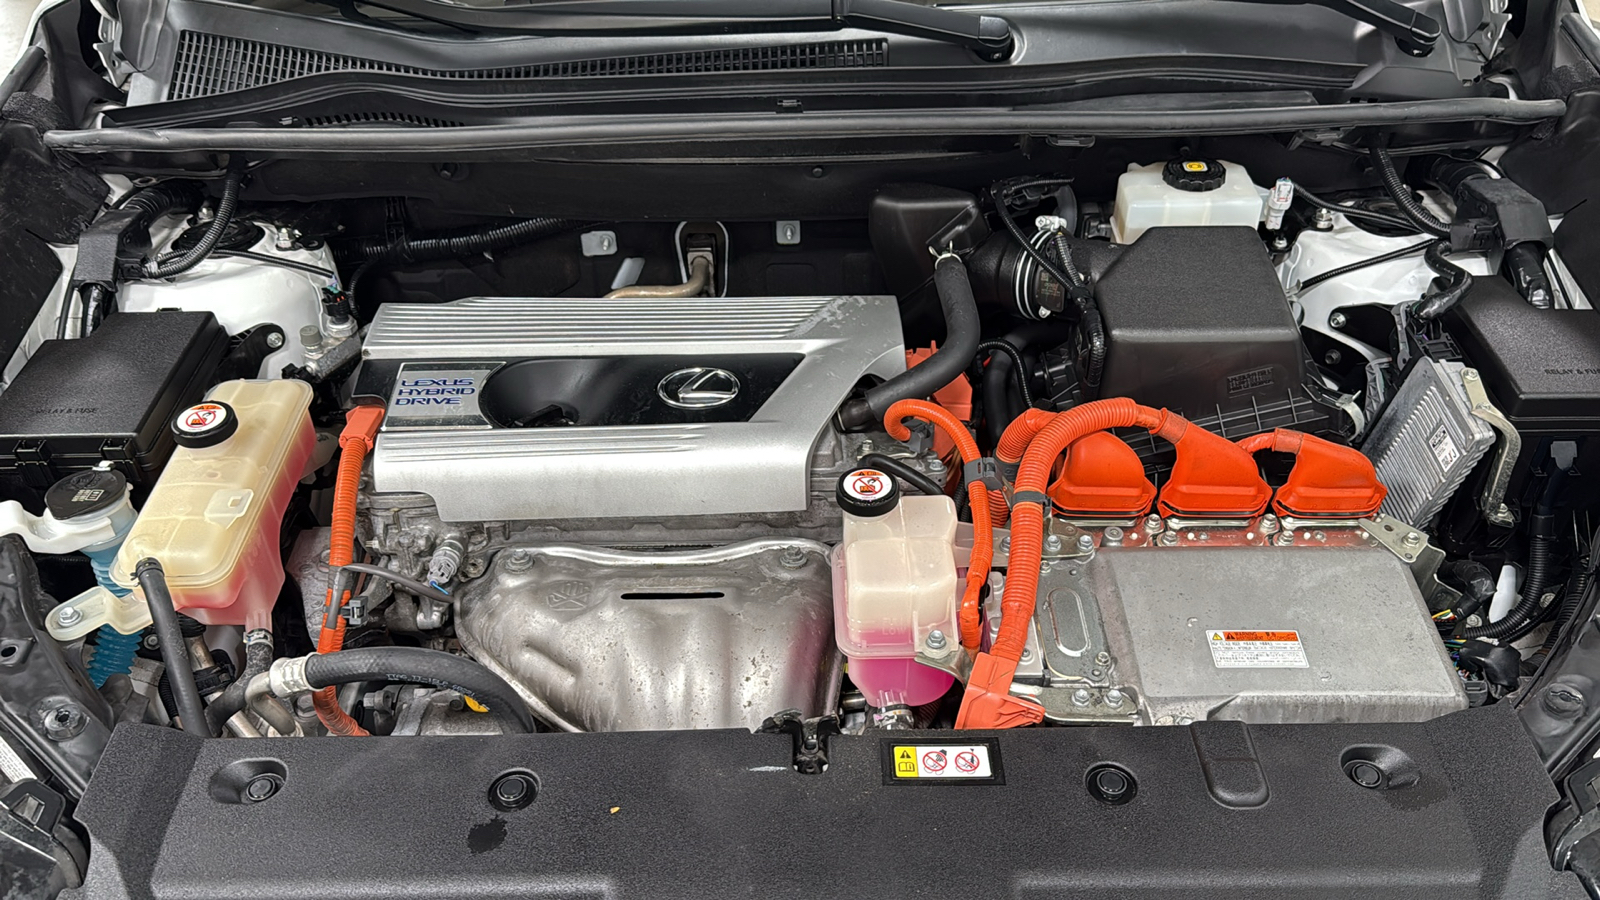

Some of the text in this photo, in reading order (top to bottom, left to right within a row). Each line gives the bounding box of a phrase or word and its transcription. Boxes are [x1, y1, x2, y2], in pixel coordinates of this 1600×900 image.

[401, 378, 474, 387] LEXUS
[398, 387, 475, 396] HYBRID
[395, 396, 462, 405] DRIVE
